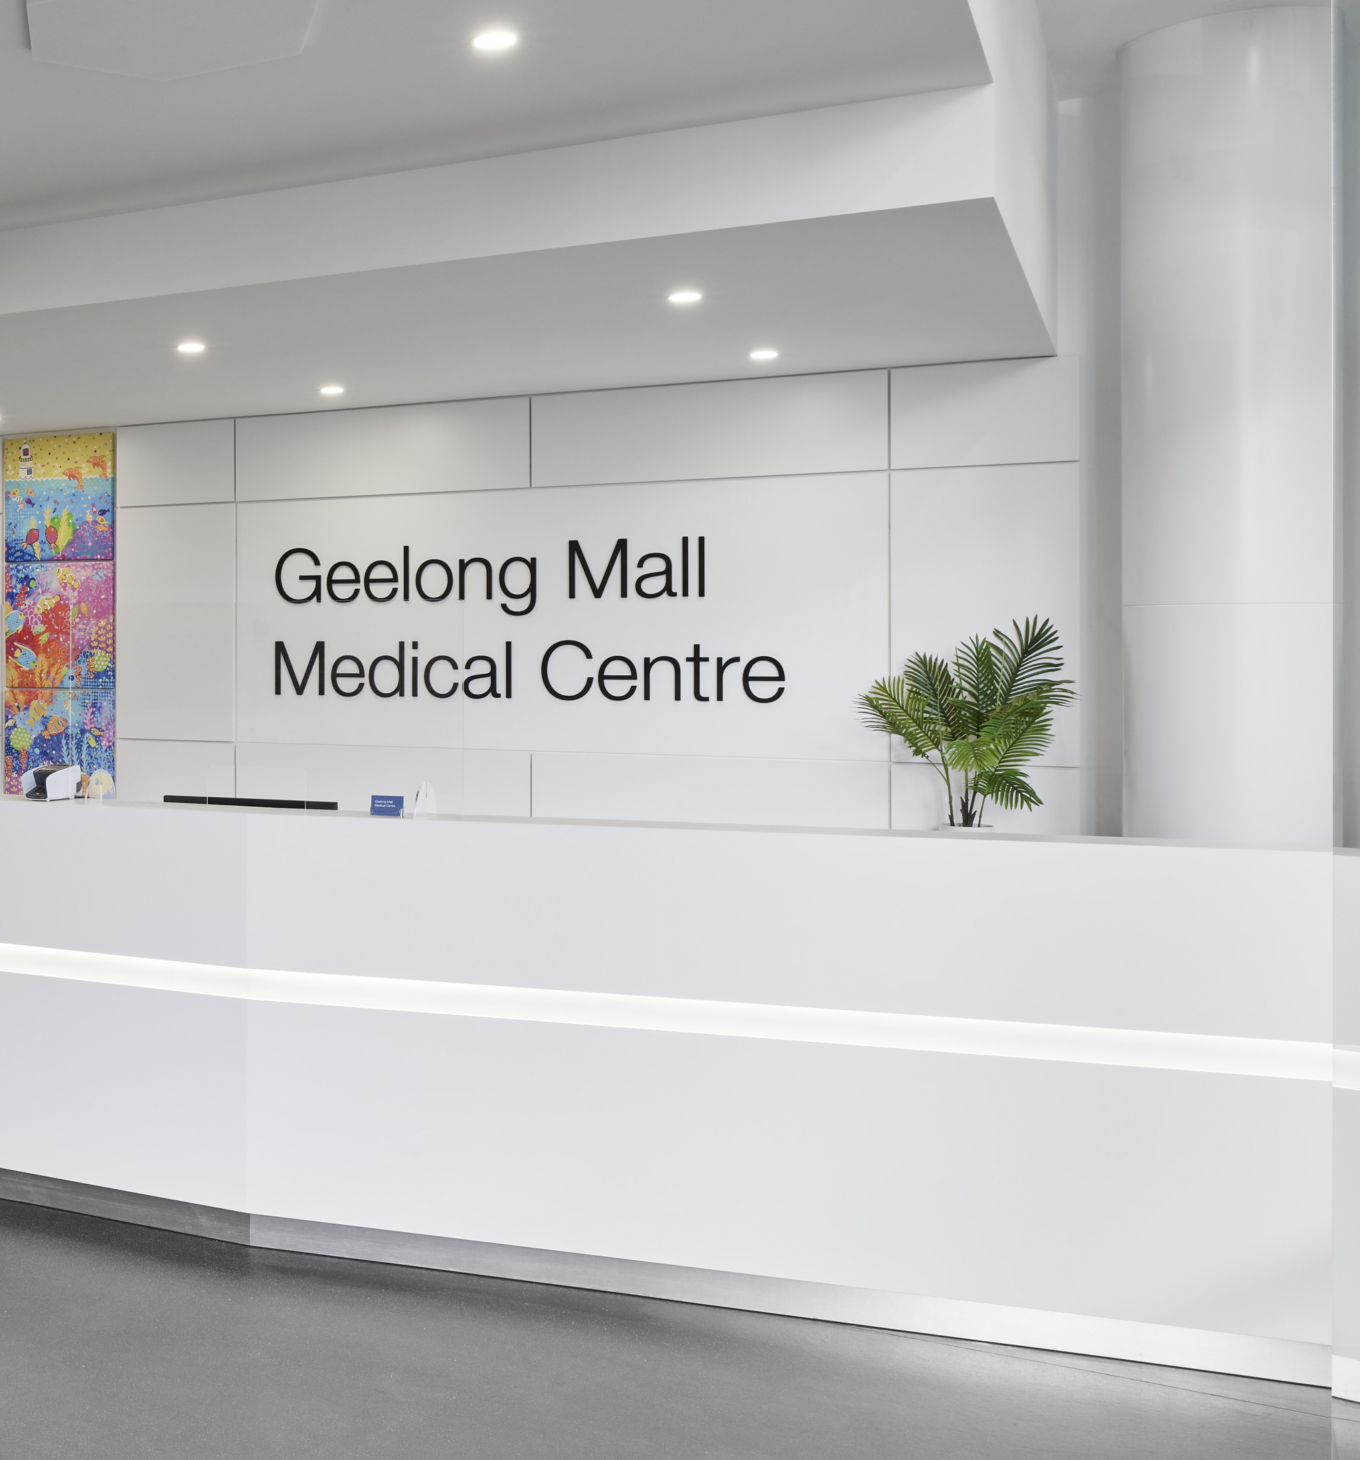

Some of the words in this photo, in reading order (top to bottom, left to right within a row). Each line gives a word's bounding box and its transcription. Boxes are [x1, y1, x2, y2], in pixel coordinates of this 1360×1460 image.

[274, 545, 537, 616] Geelong
[567, 536, 706, 599] Mall
[274, 640, 512, 699] Medical
[540, 639, 786, 703] Centre
